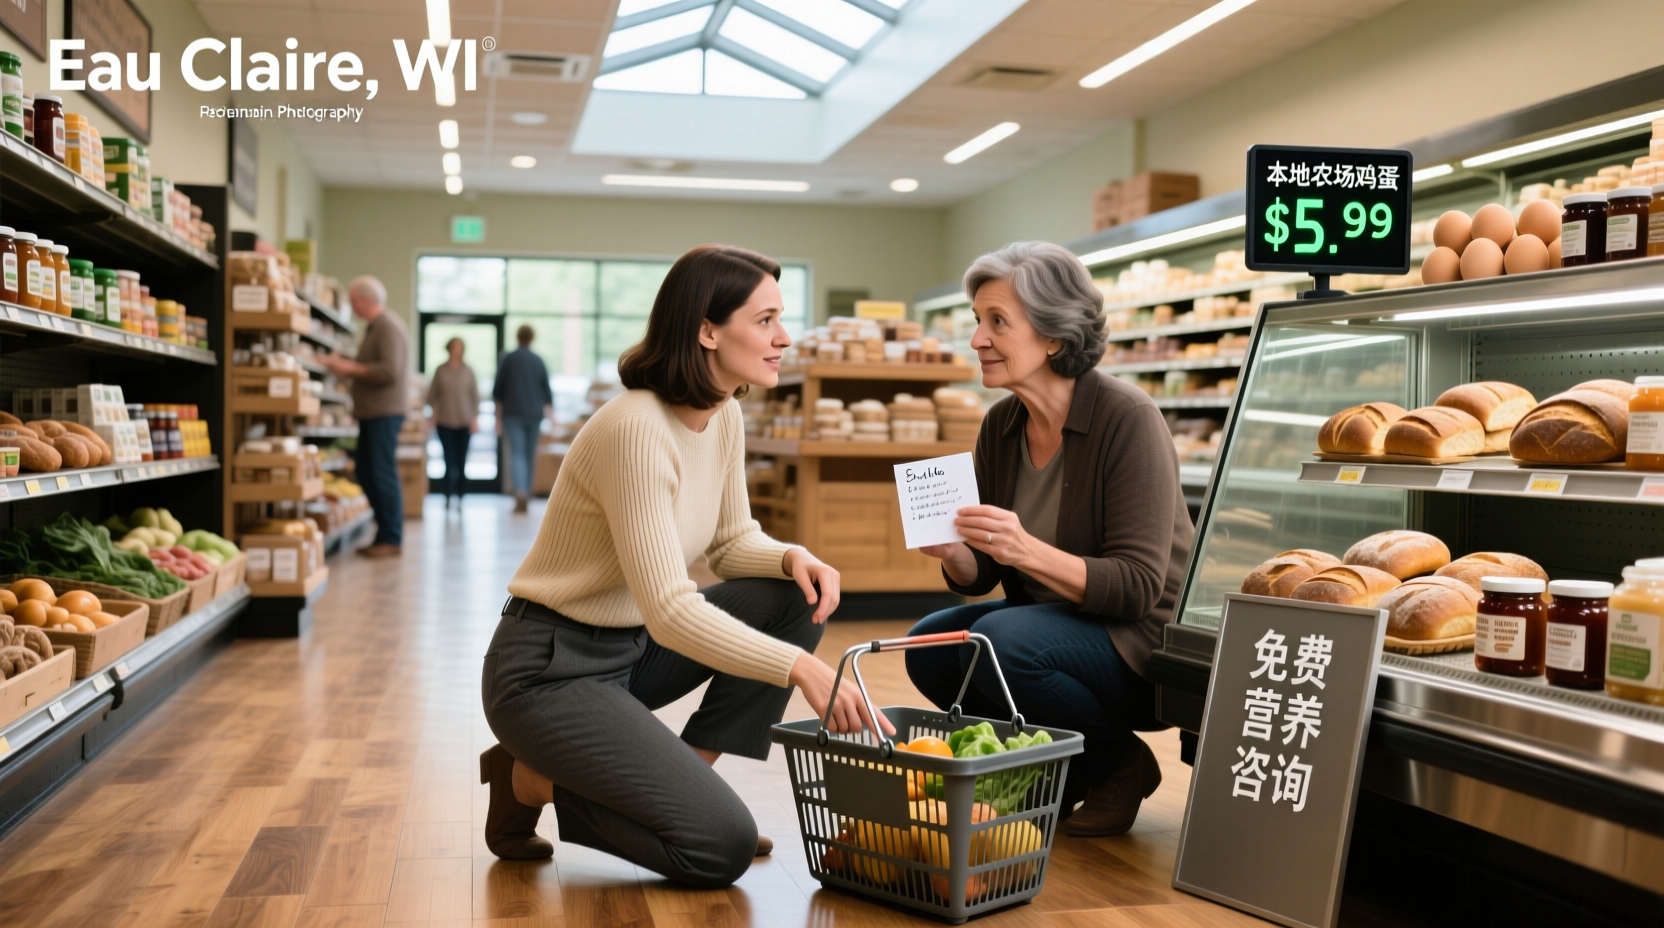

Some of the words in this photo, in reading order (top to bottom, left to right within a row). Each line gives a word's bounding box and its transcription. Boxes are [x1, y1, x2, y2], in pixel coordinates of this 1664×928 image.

[1266, 160, 1400, 191] 本地农场鸡蛋
[1264, 196, 1393, 254] $5.99
[1249, 628, 1333, 690] 免费
[1241, 686, 1323, 749] 营养
[1231, 744, 1313, 812] 咨询
